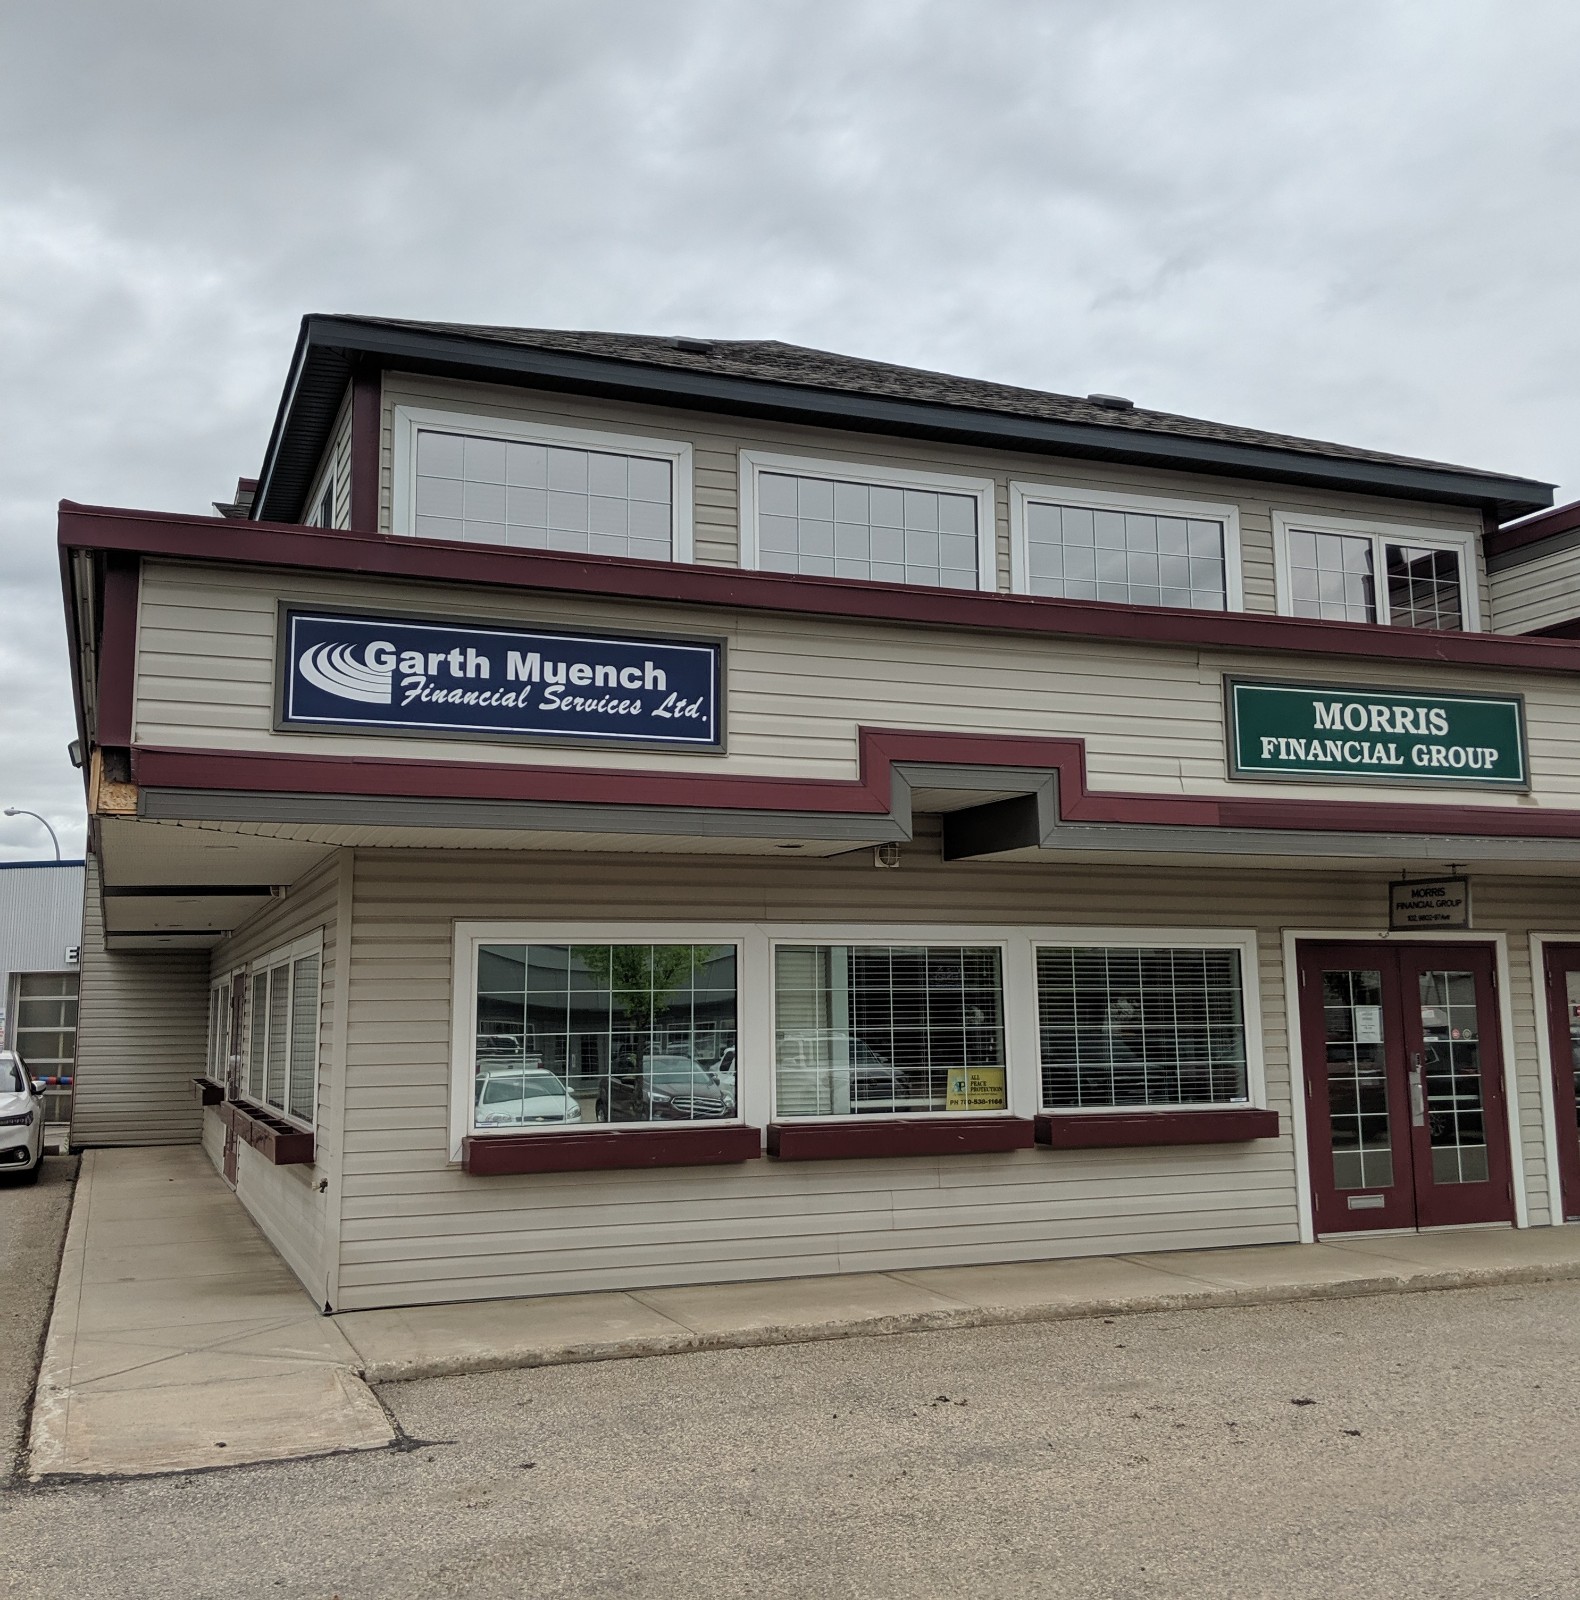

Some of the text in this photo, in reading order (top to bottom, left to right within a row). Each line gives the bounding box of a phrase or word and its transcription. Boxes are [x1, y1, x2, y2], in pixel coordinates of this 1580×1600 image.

[364, 640, 667, 691] Garth Muench
[400, 676, 709, 722] Financial Services Ltd.
[1312, 701, 1450, 736] MORRIS
[1259, 736, 1499, 769] FINANCIAL GROUP
[1396, 899, 1462, 910] FINANCIAL GROUP
[1411, 887, 1445, 898] MORRIS
